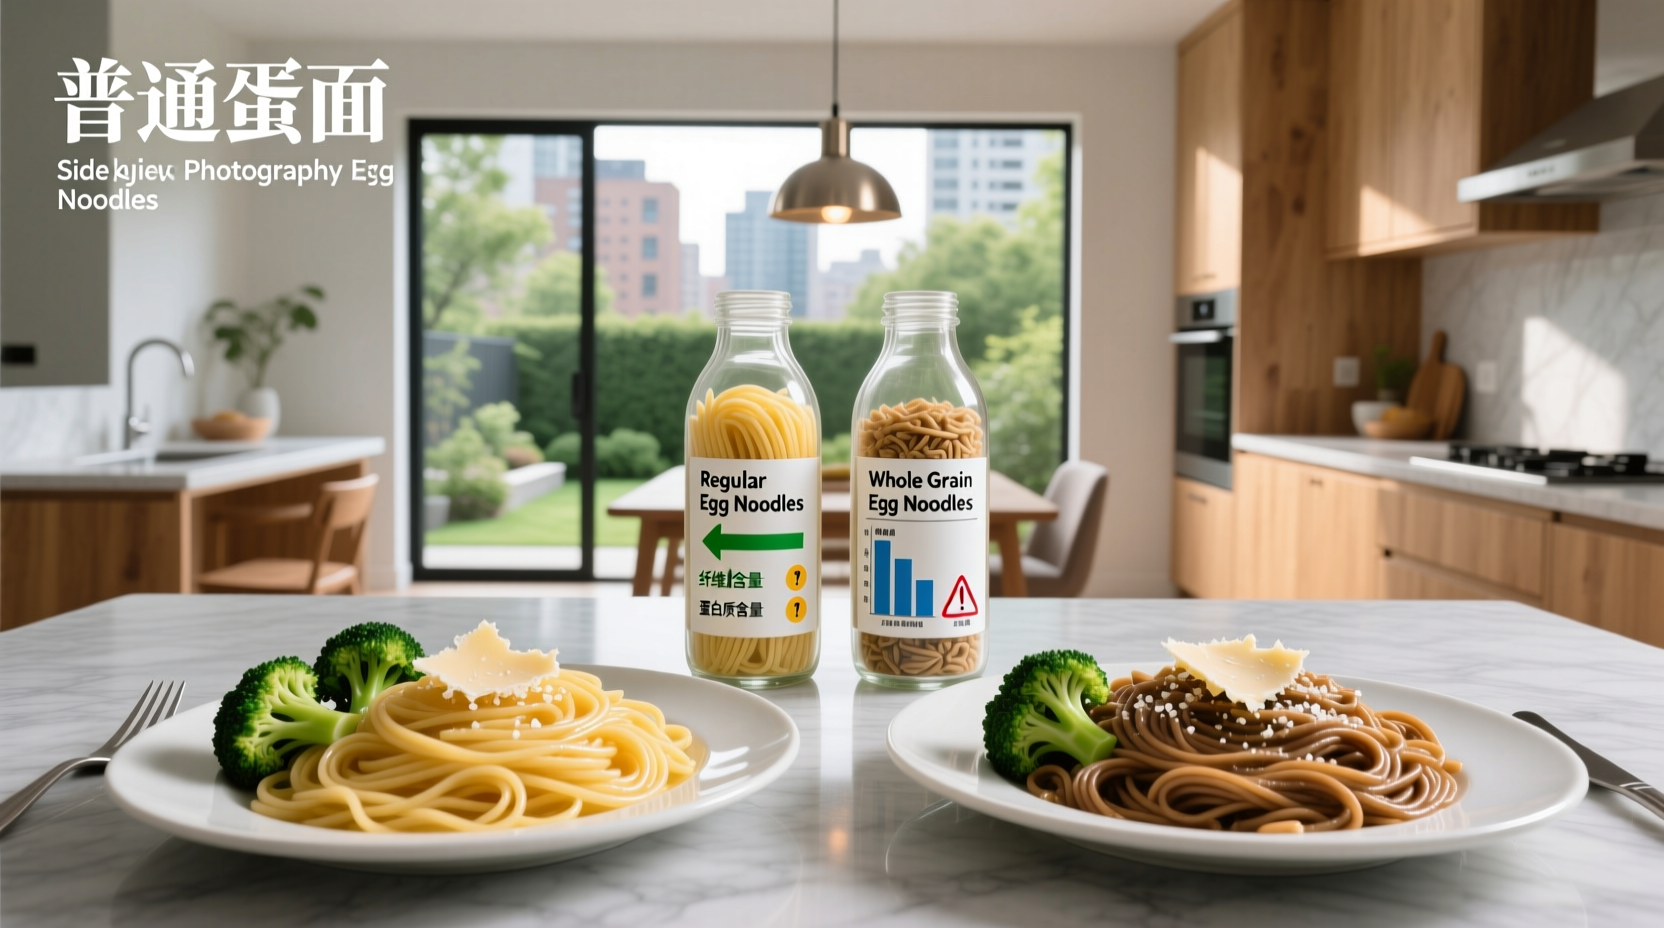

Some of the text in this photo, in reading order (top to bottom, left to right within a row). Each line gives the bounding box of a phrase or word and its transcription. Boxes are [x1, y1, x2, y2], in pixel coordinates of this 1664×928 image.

[700, 470, 767, 493] Regular
[868, 470, 973, 489] Whole Grain
[700, 494, 804, 517] Egg Noodles
[869, 494, 973, 516] Egg Noodles
